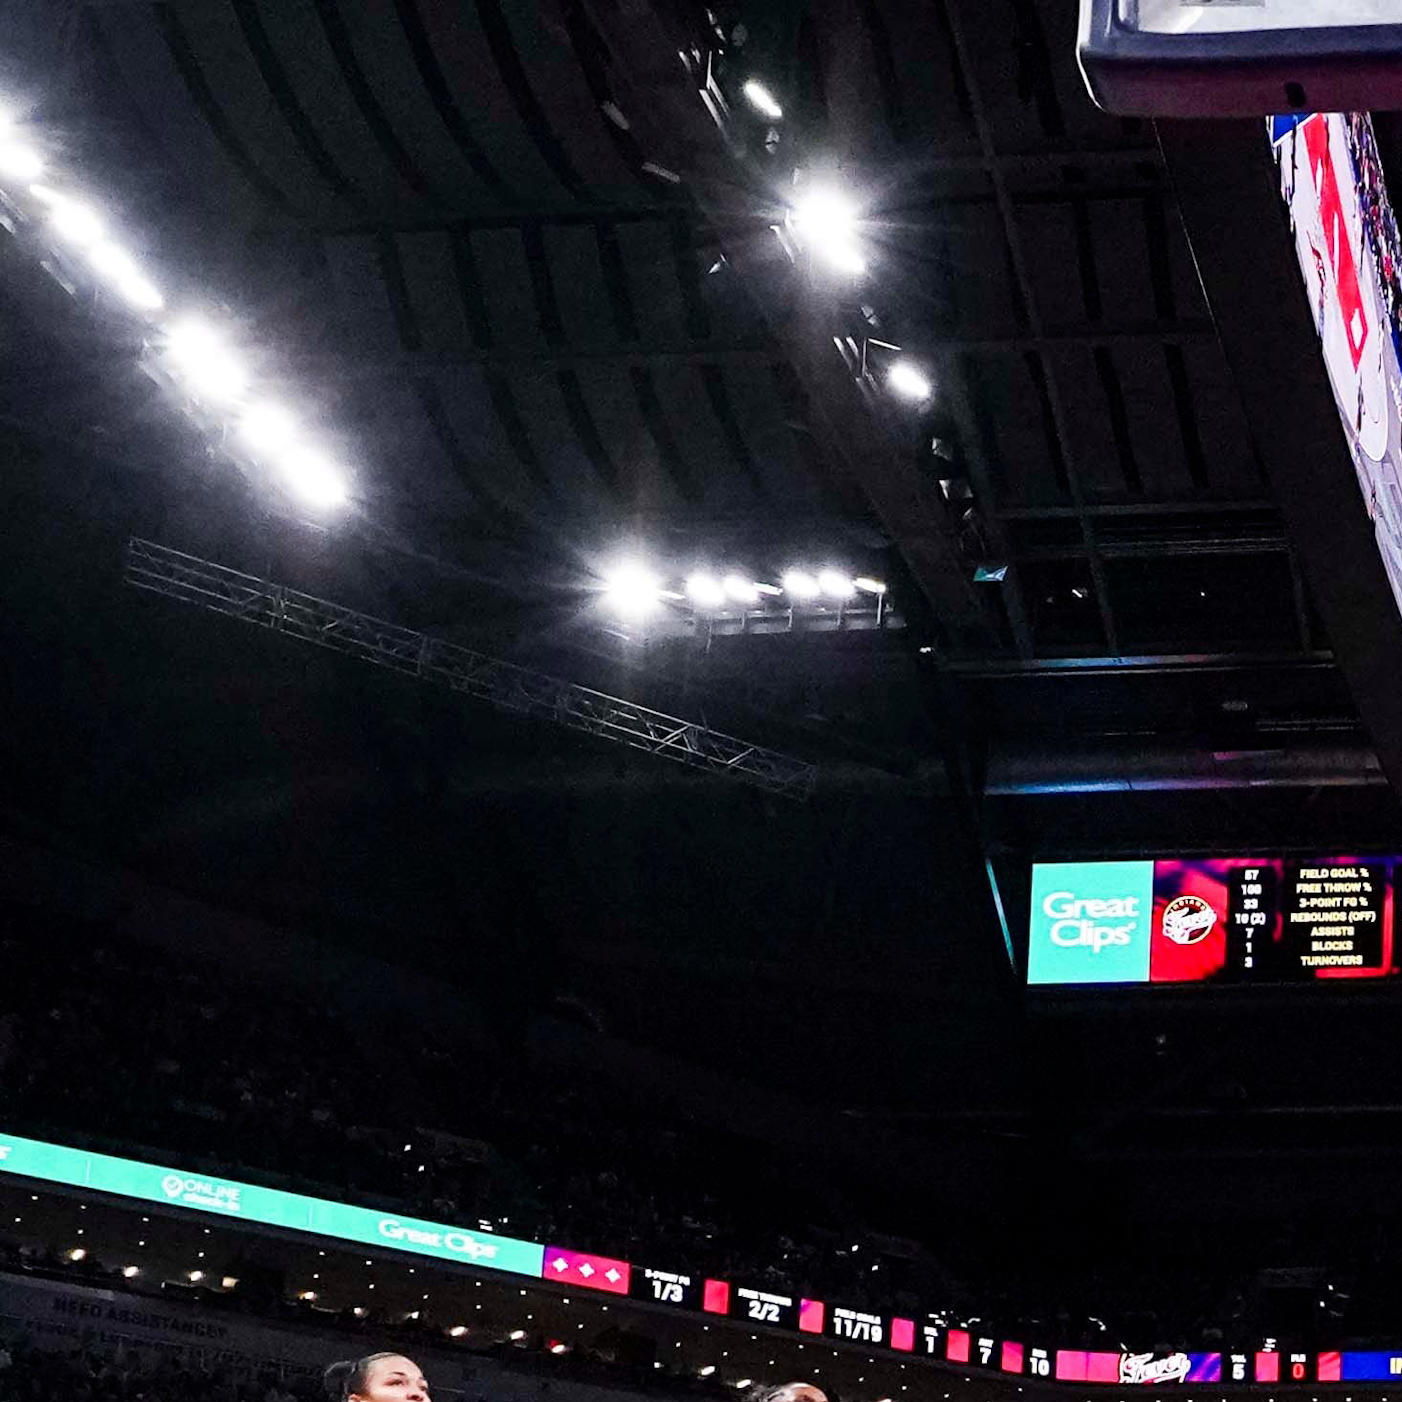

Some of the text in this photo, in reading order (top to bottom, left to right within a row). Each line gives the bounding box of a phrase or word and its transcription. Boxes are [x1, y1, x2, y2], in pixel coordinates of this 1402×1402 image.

[1300, 869, 1329, 879] FIELD
[1330, 868, 1358, 878] GOAL
[1296, 883, 1323, 894] FREE
[1323, 882, 1358, 893] THROW
[1043, 891, 1140, 918] Great
[1290, 912, 1347, 923] REBOUNDS
[1348, 911, 1377, 923] (OFF)
[1049, 918, 1136, 953] Clips
[1311, 926, 1355, 937] ASSISTS
[1311, 941, 1354, 951] BLOCKS
[1300, 955, 1363, 966] TURNOVERS
[183, 1177, 241, 1201] ONLINE
[378, 1218, 498, 1260] Great Clips
[652, 1280, 684, 1303] 1/3
[749, 1300, 780, 1323] 2/2
[833, 1316, 883, 1344] 11/19
[925, 1336, 935, 1354] 1
[980, 1347, 992, 1365] 7
[1030, 1356, 1050, 1376] 10
[1232, 1363, 1245, 1381] 5
[1292, 1362, 1305, 1381] 0
